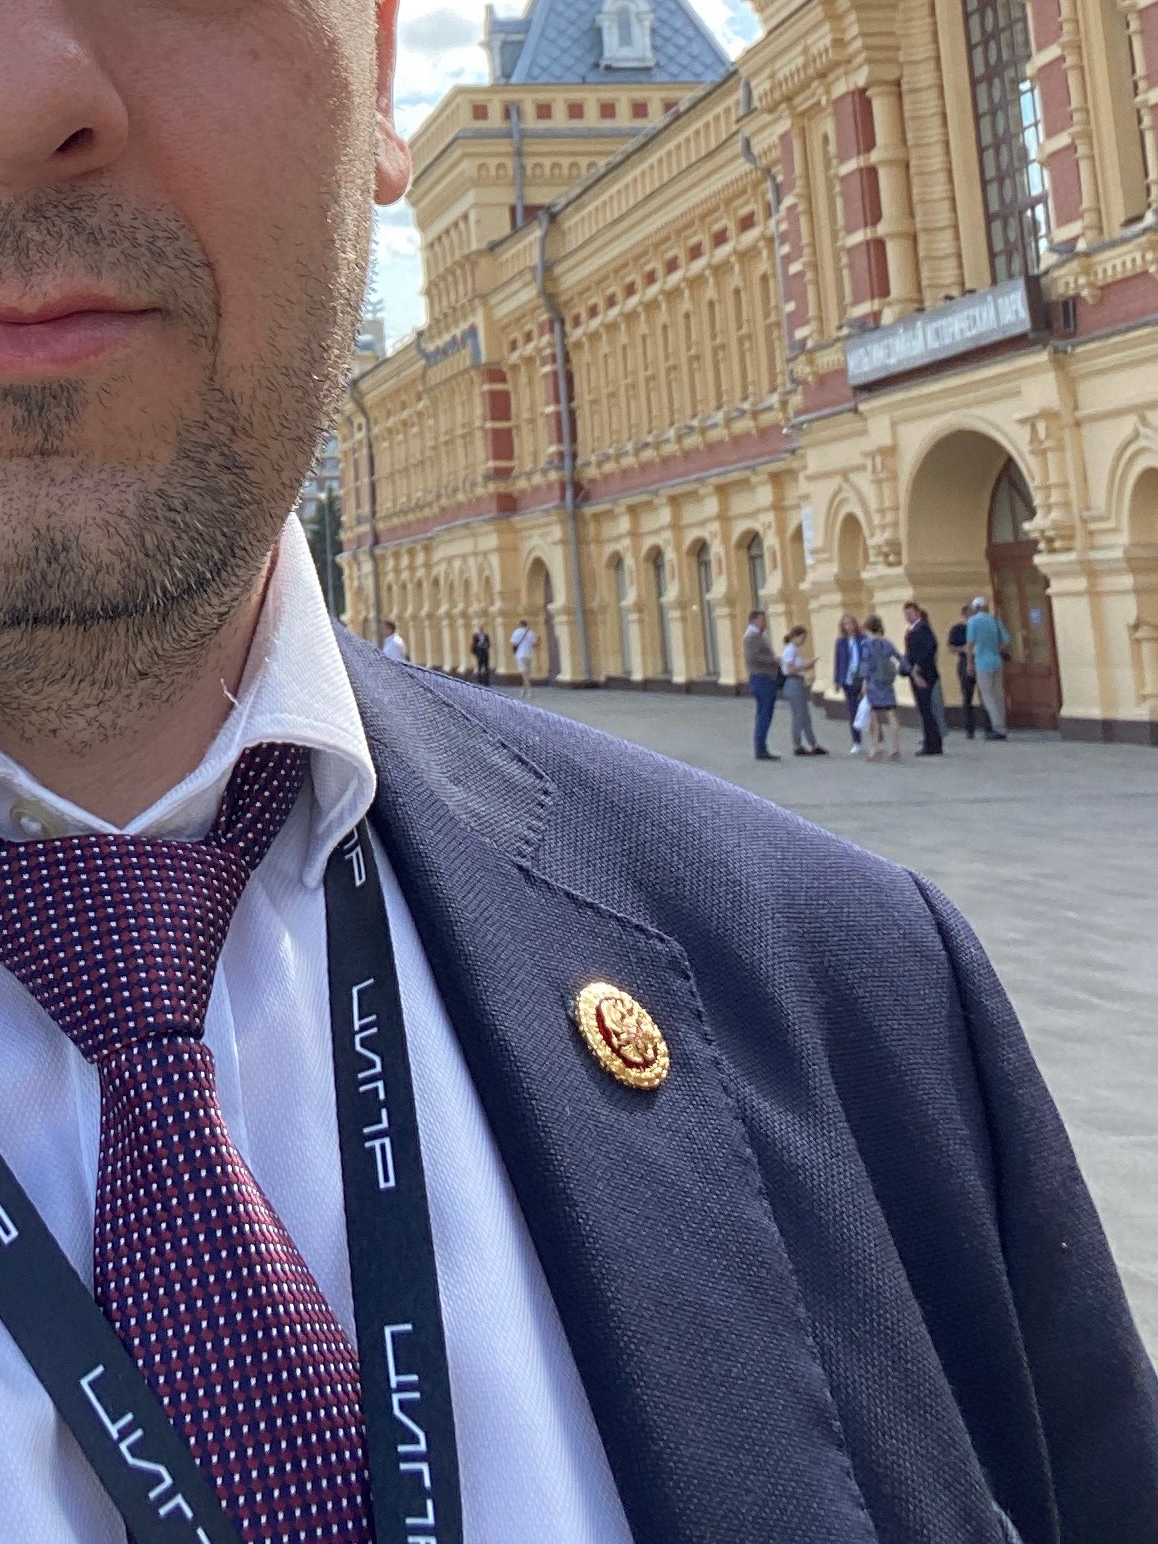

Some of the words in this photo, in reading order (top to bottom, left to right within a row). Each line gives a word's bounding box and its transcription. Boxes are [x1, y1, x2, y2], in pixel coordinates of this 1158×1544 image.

[352, 978, 396, 1190] ЦИПР
[80, 1364, 211, 1544] ЦИП
[384, 1323, 438, 1544] ЦИП
